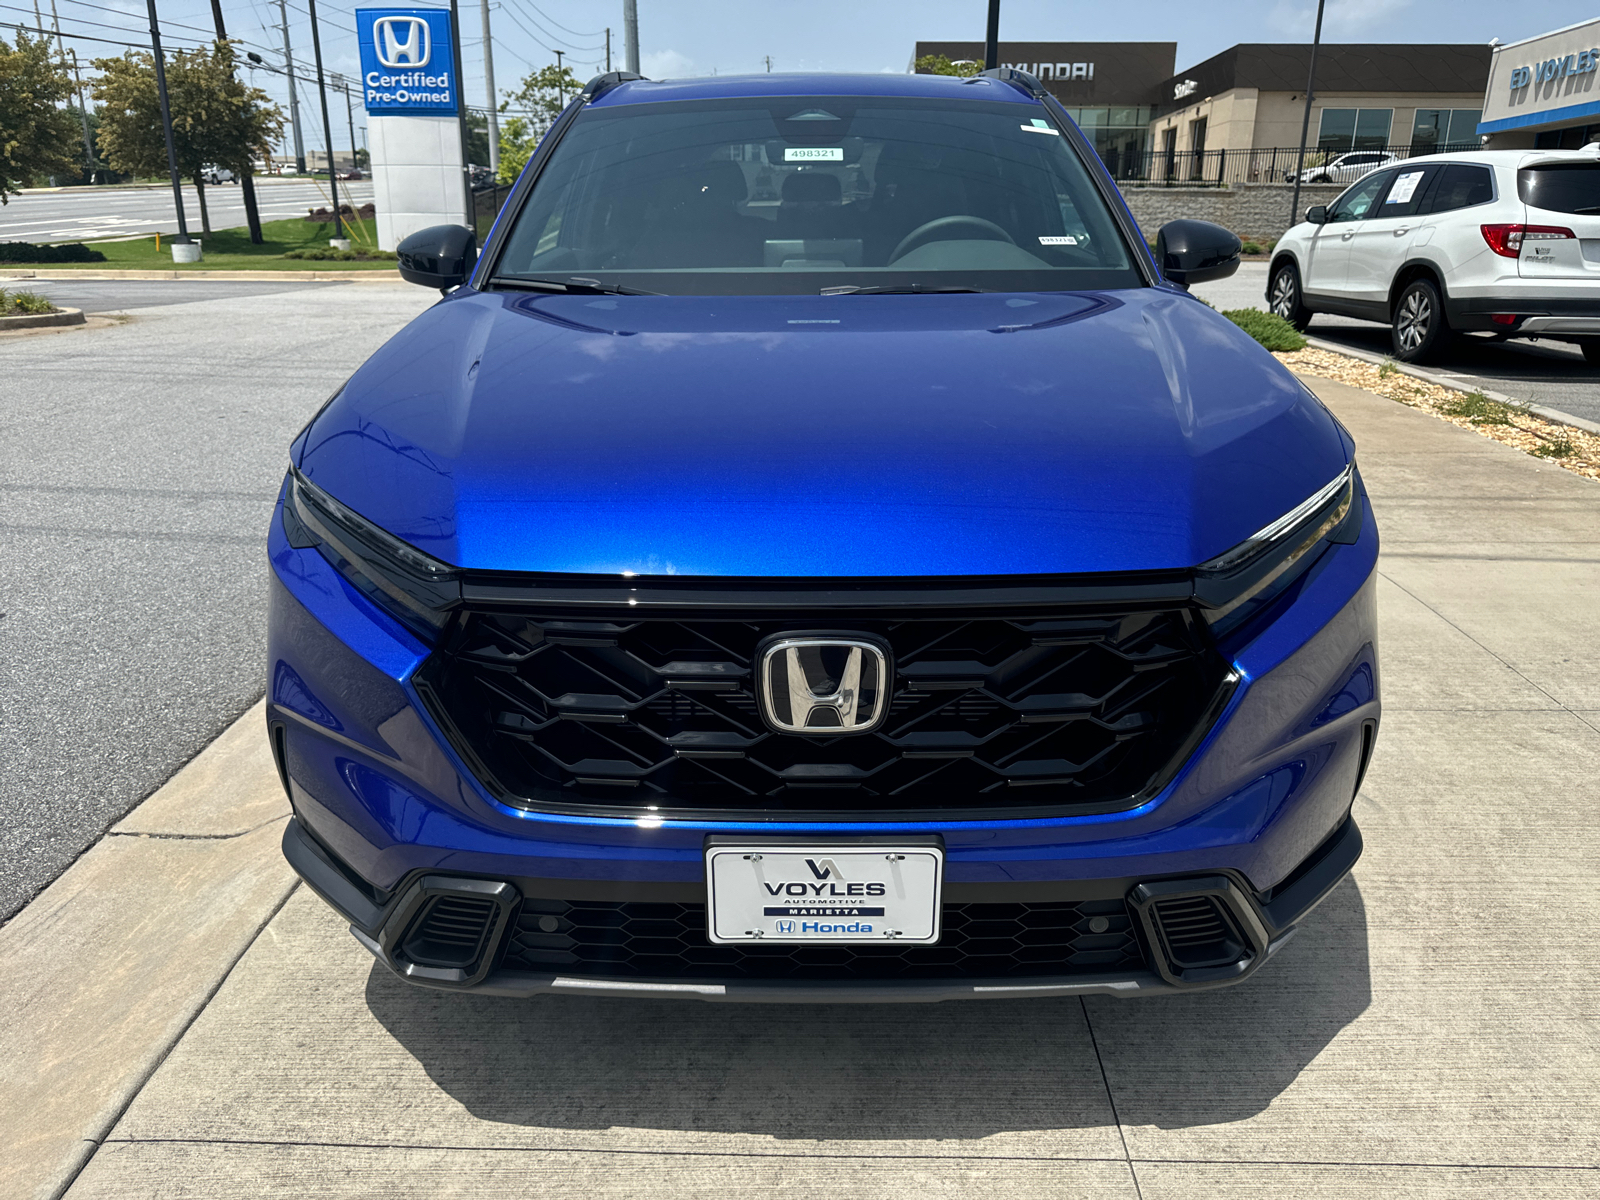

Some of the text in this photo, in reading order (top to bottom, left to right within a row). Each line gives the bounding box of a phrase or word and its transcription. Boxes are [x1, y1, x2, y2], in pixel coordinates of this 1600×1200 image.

[1000, 62, 1095, 81] YUNDAI
[1509, 47, 1599, 90] ED VOYLES
[366, 71, 449, 88] Certified
[367, 89, 450, 103] Pre-Owned
[791, 149, 835, 158] 498321
[763, 882, 886, 896] VOYLES
[802, 922, 873, 933] Honda
